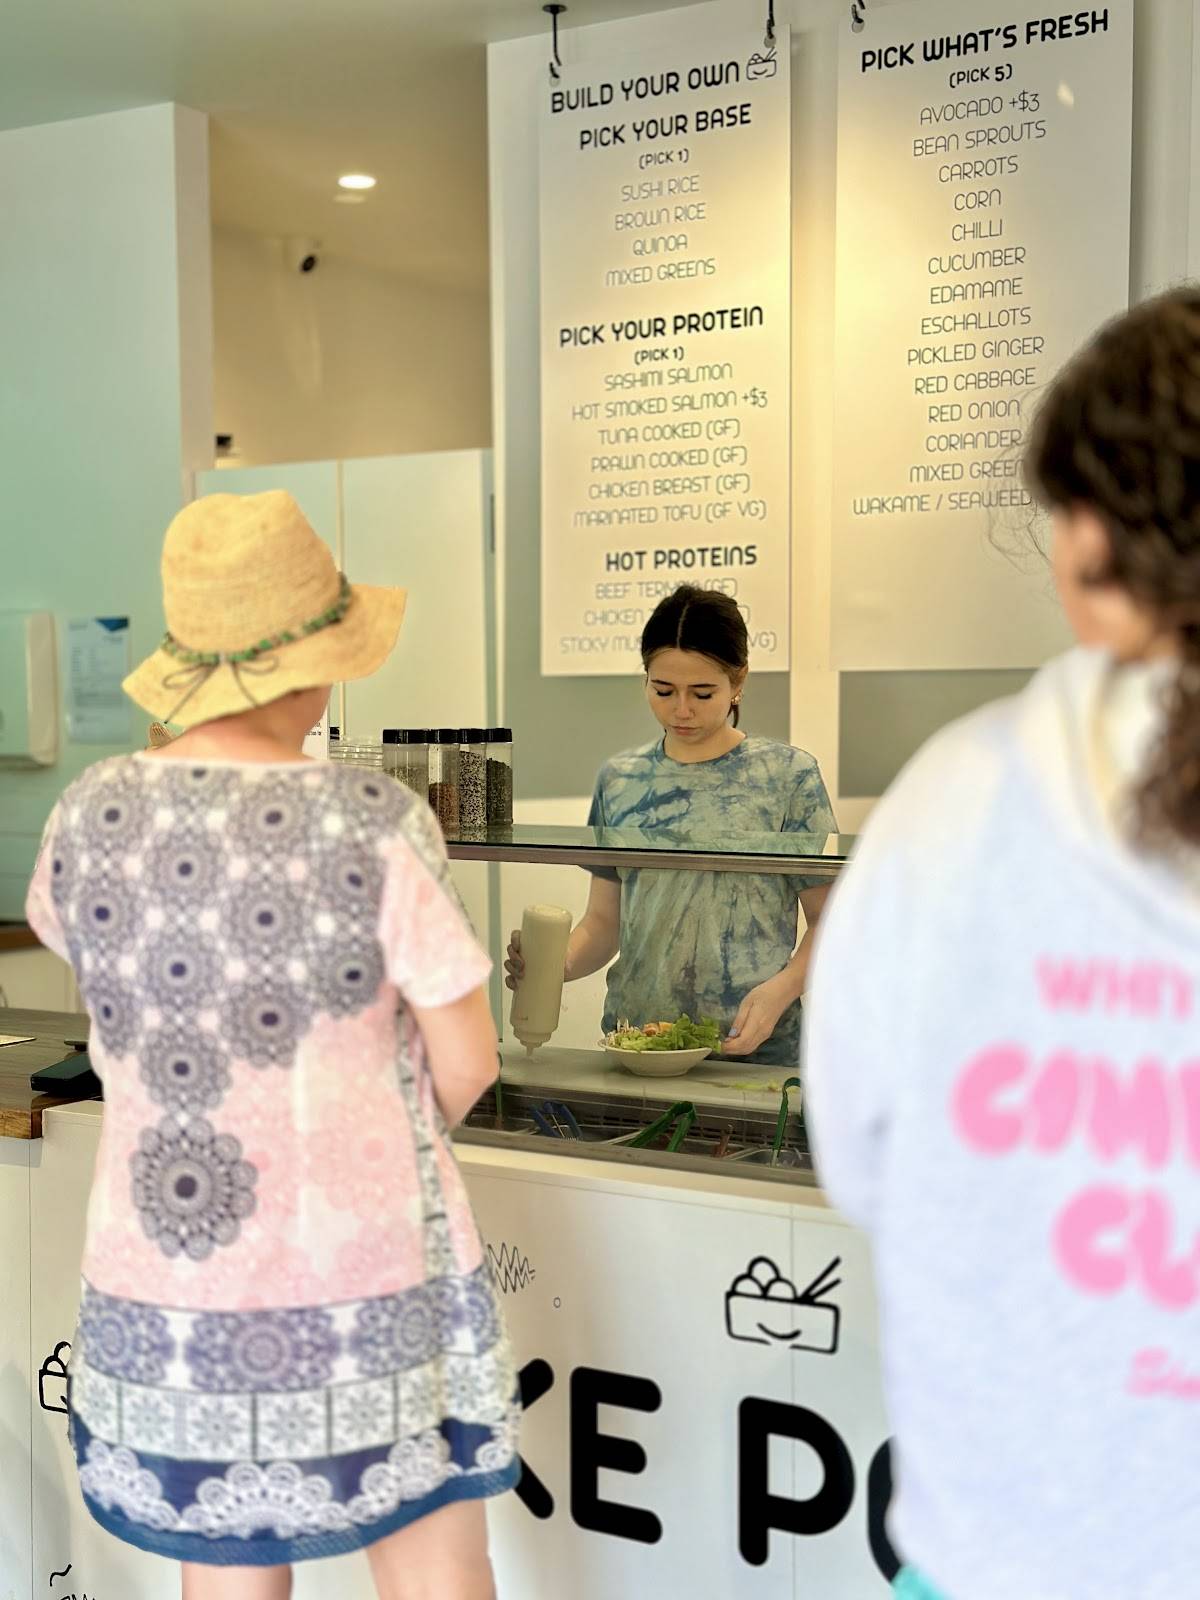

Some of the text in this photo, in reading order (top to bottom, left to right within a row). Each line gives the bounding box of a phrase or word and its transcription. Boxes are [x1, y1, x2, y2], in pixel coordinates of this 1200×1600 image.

[861, 9, 1108, 72] PICK WHAT'S FRESH
[551, 61, 740, 113] BUILD YOUR OWN
[949, 63, 1013, 88] (PICK 5)
[920, 90, 1040, 125] AVOCADO +$3
[580, 103, 752, 150] PICK YOUR BASE
[913, 120, 1047, 157] BEAN SPROUTS
[638, 148, 689, 169] (PICK 1)
[938, 155, 1019, 183] CARROTS
[621, 175, 700, 202] SUSHI RICE
[954, 188, 1002, 211] CORN
[615, 203, 706, 231] BROWN RICE
[952, 219, 1003, 241] CHILLI
[633, 234, 688, 256] QUINOA
[606, 258, 716, 287] MIXED GREENS
[928, 246, 1026, 275] CUCUMBER
[930, 277, 1023, 305] EDAMAME
[560, 305, 764, 347] PICK YOUR PROTEIN
[921, 306, 1032, 335] ESCHALLOTS
[634, 346, 685, 365] (PICK 1)
[908, 336, 1045, 366] PICKLED GINGER
[604, 363, 733, 391] SASHIMI SALMON
[915, 367, 1036, 395] RED CABBAGE
[572, 387, 768, 421] HOT SMOKED SALMON +$3
[928, 399, 1020, 424] RED ONION
[599, 418, 741, 445] TUNA COOKED (GF)
[926, 428, 1023, 453] CORIANDER
[591, 445, 748, 473] PRAWN COOKED (GF)
[910, 458, 1025, 483] MIXED GREEN
[588, 473, 750, 500] CHICKEN BREAST (GF)
[574, 499, 767, 528] MARINATED TOFU (GF VG)
[853, 494, 931, 515] WAKAME
[935, 494, 943, 511] /
[606, 545, 758, 572] HOT PROTEINS
[596, 582, 630, 600] BEEF
[583, 608, 644, 626] CHICKEN
[559, 635, 607, 654] STICKY
